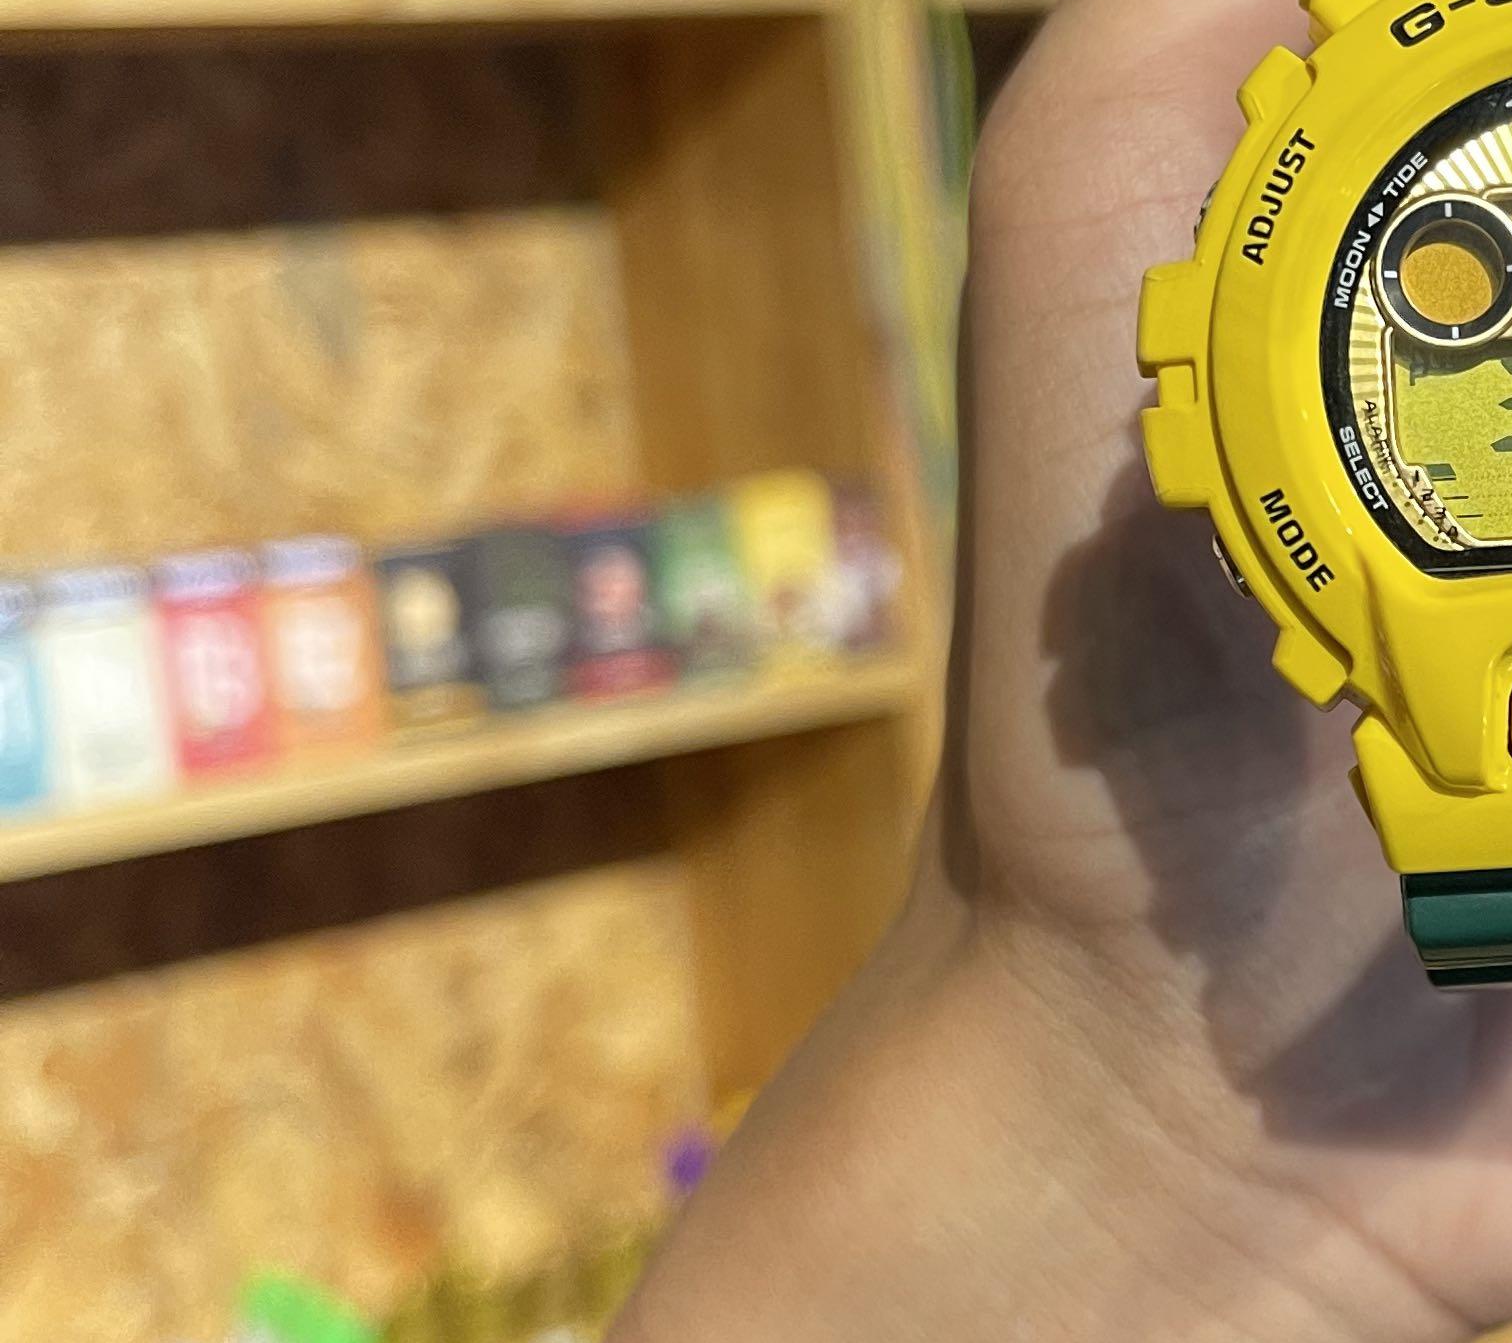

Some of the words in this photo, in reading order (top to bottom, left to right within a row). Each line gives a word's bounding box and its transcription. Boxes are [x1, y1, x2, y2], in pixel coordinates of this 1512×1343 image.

[1241, 127, 1316, 266] ADJUST
[1333, 229, 1372, 309] MOON
[1382, 151, 1429, 198] TIDE
[1339, 426, 1389, 511] SELECT
[1259, 488, 1336, 593] MODE
